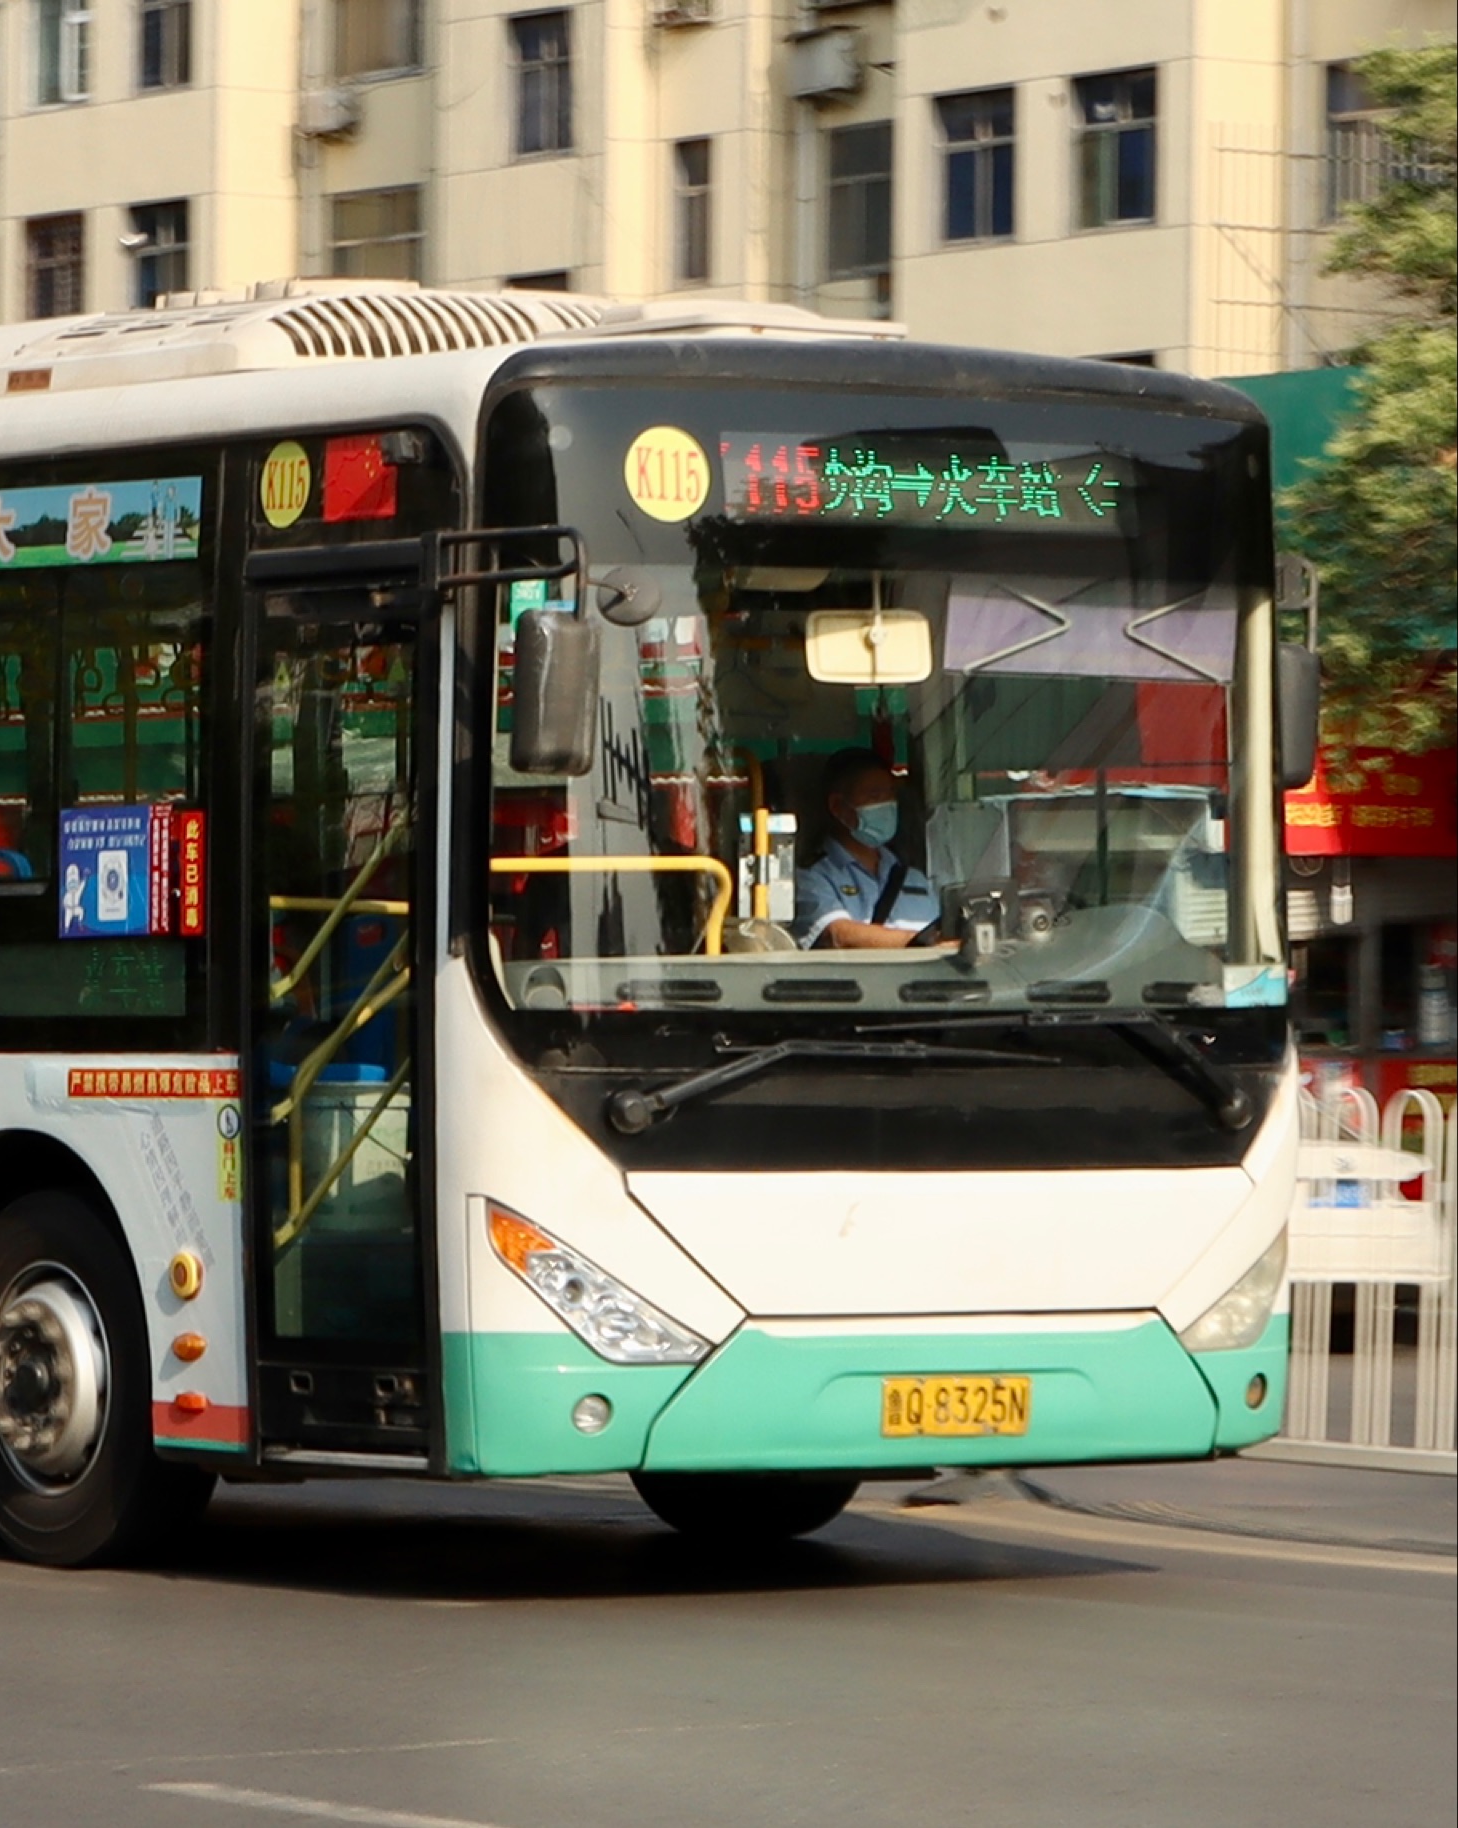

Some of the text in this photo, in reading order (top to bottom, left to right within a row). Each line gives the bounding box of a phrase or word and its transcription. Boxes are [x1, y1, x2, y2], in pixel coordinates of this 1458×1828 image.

[265, 460, 306, 510] K115
[635, 446, 700, 504] K115
[720, 442, 820, 514] 115
[185, 819, 200, 928] 此车已消毒
[71, 1071, 238, 1094] 严禁携带易燃易爆危险品上车
